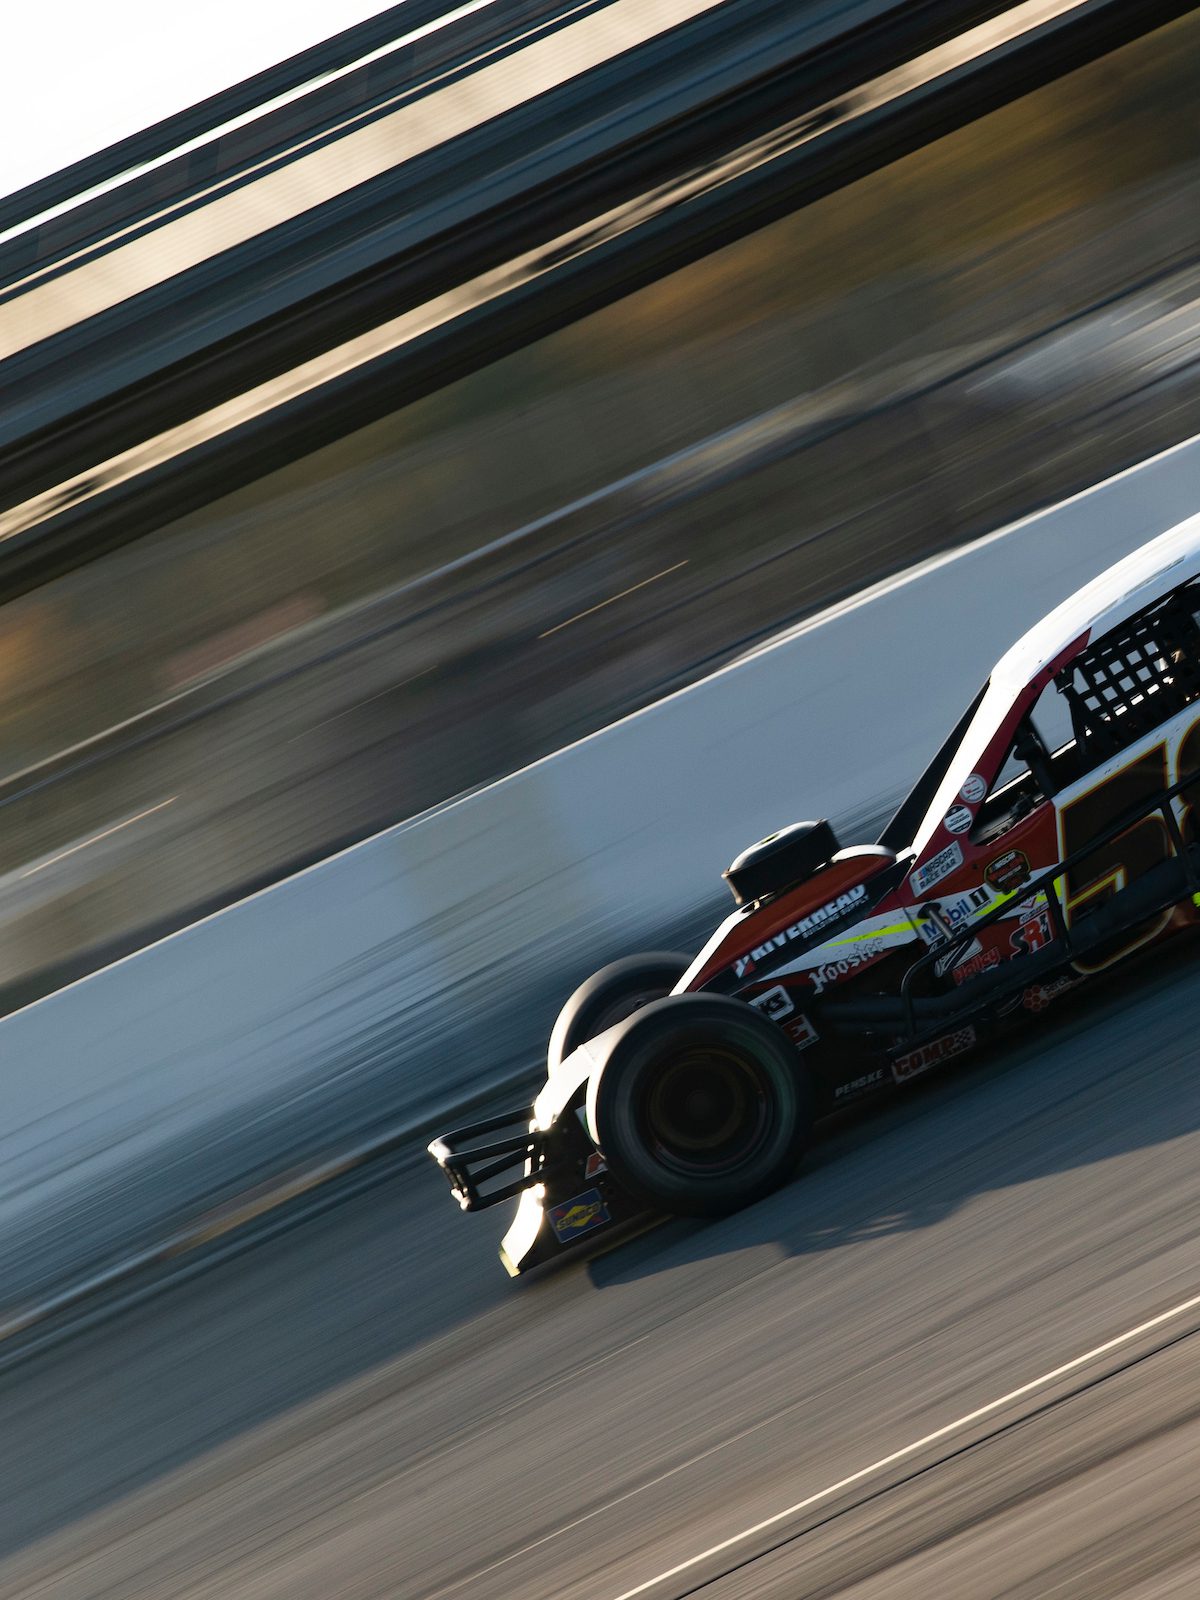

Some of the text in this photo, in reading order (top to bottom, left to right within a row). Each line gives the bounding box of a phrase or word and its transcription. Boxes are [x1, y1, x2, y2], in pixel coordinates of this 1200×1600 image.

[919, 858, 957, 889] RACE CAR
[922, 848, 954, 878] NASCAR
[750, 884, 867, 962] RIVERHEAD
[895, 1036, 955, 1077] COMP
[835, 1068, 885, 1099] PENSKE
